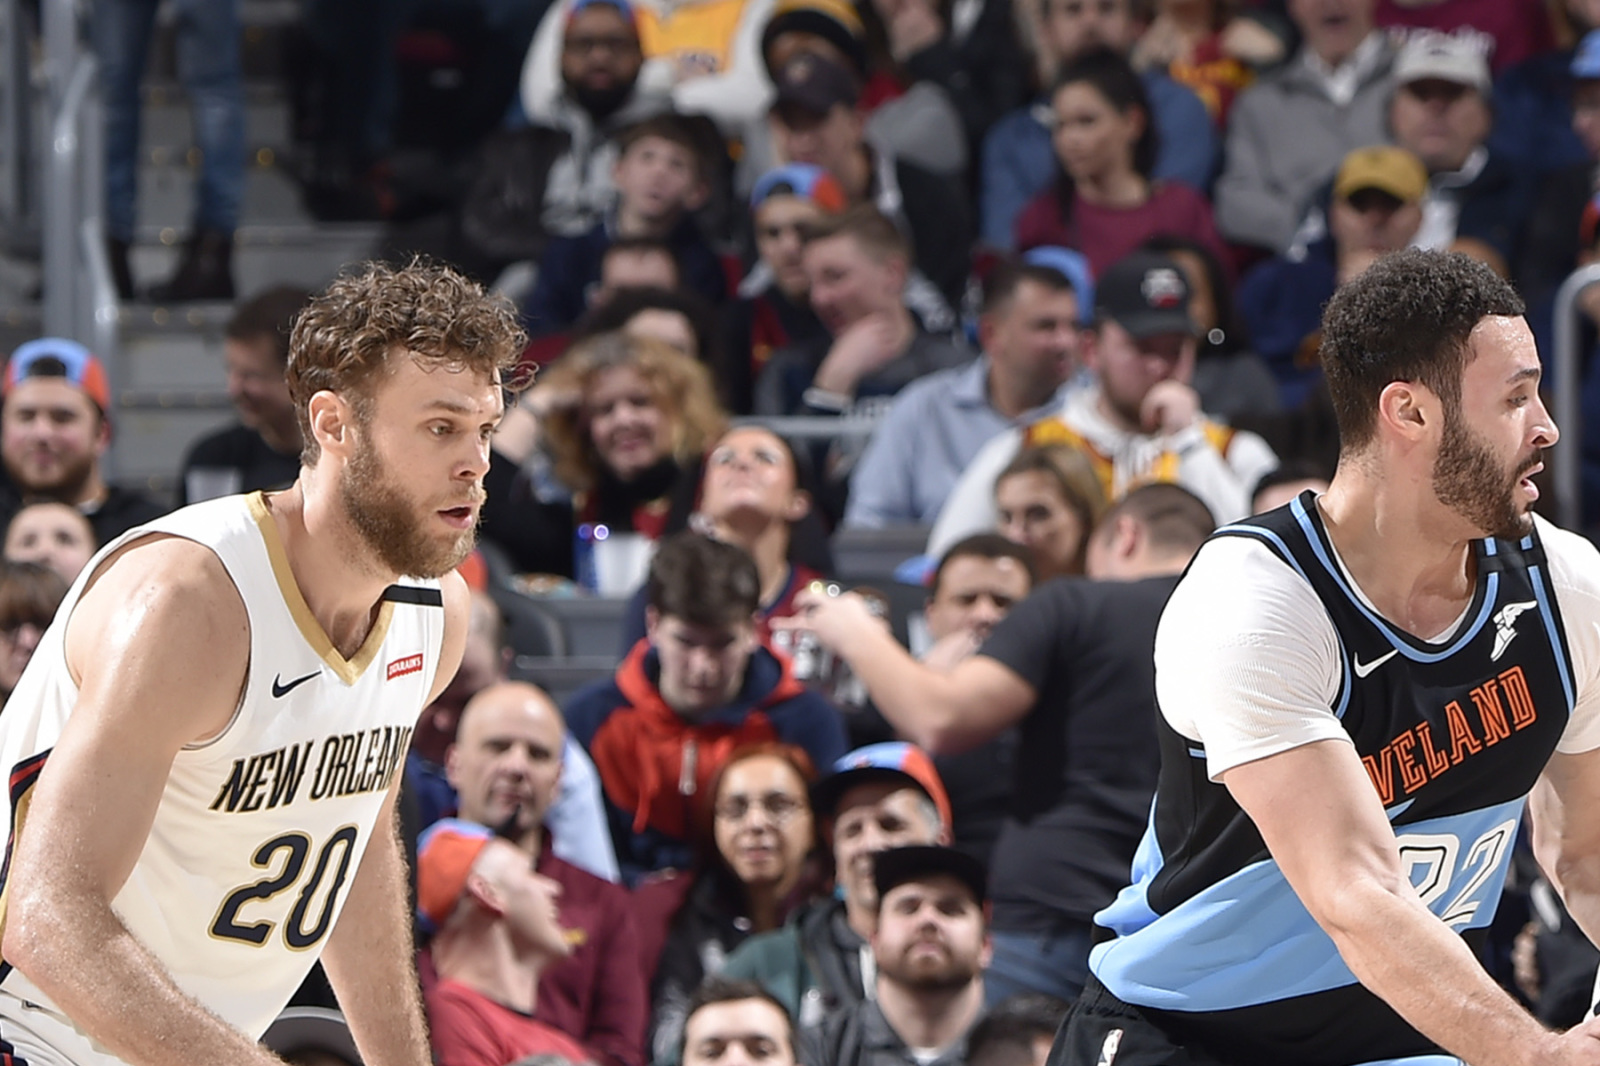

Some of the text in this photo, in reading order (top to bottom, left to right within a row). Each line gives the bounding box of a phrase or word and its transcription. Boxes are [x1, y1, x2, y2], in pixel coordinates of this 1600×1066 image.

[208, 727, 413, 814] NEW ORLEAN
[1362, 665, 1537, 805] VELAND
[208, 822, 359, 952] 20
